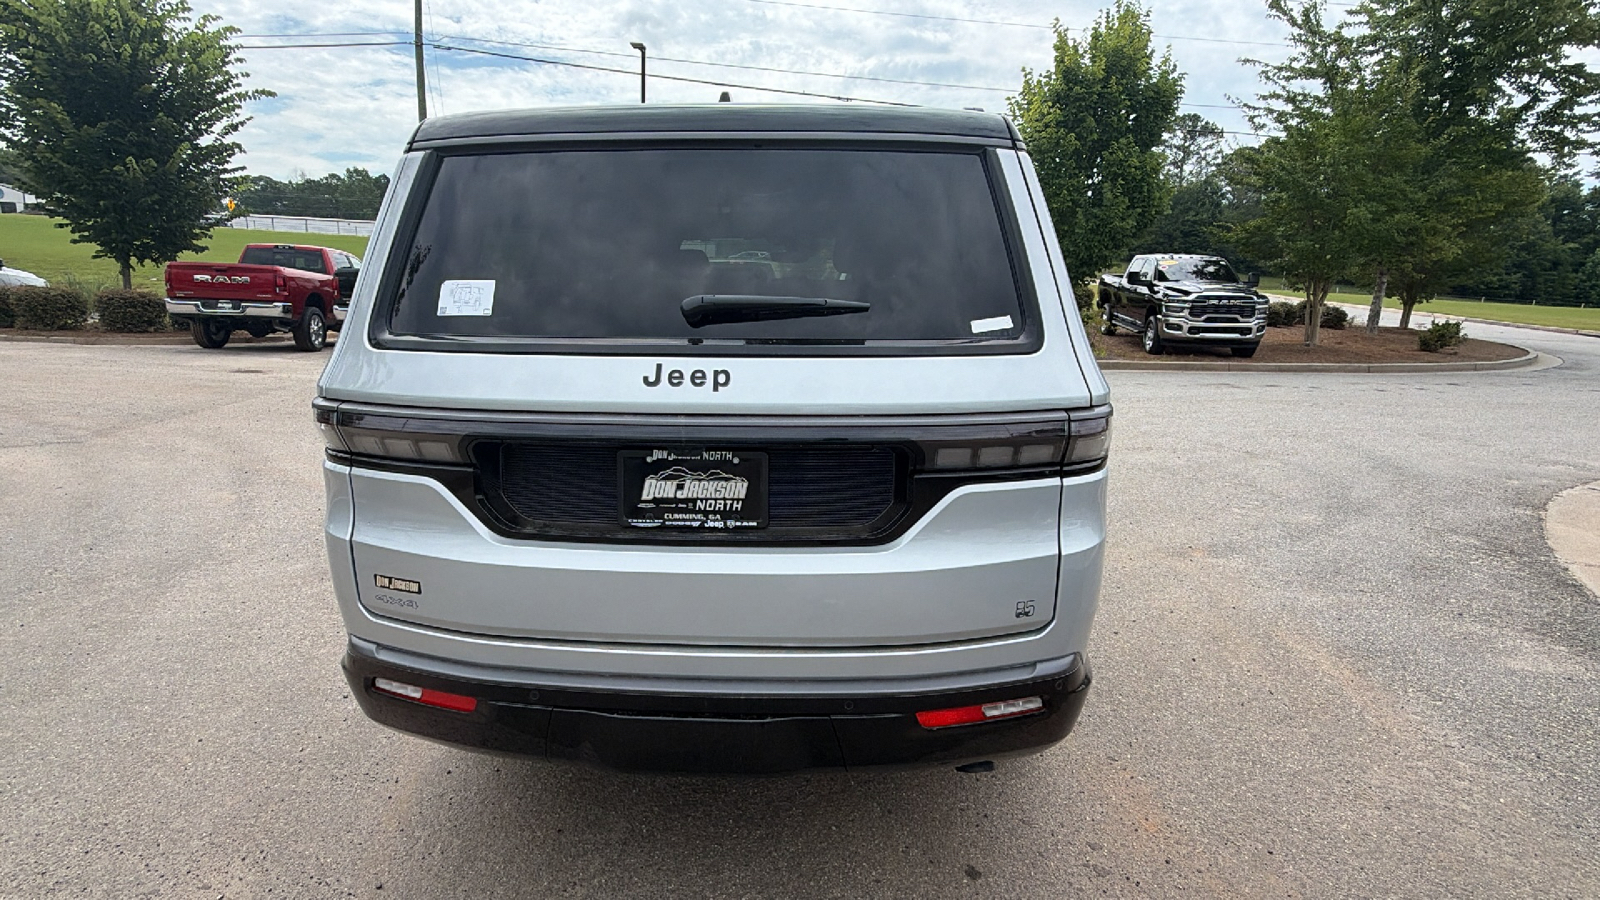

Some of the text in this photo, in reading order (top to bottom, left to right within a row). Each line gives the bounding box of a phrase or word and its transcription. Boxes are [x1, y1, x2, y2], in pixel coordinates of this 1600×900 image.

[193, 274, 251, 284] RAM
[642, 362, 731, 392] Jeep
[652, 449, 668, 461] DON
[702, 451, 733, 461] NORTH
[641, 479, 749, 500] DON JACKSON
[696, 500, 743, 511] NORTH
[664, 513, 706, 521] CUMMING,
[704, 521, 725, 529] Jeep
[376, 575, 419, 592] DON JACKSON
